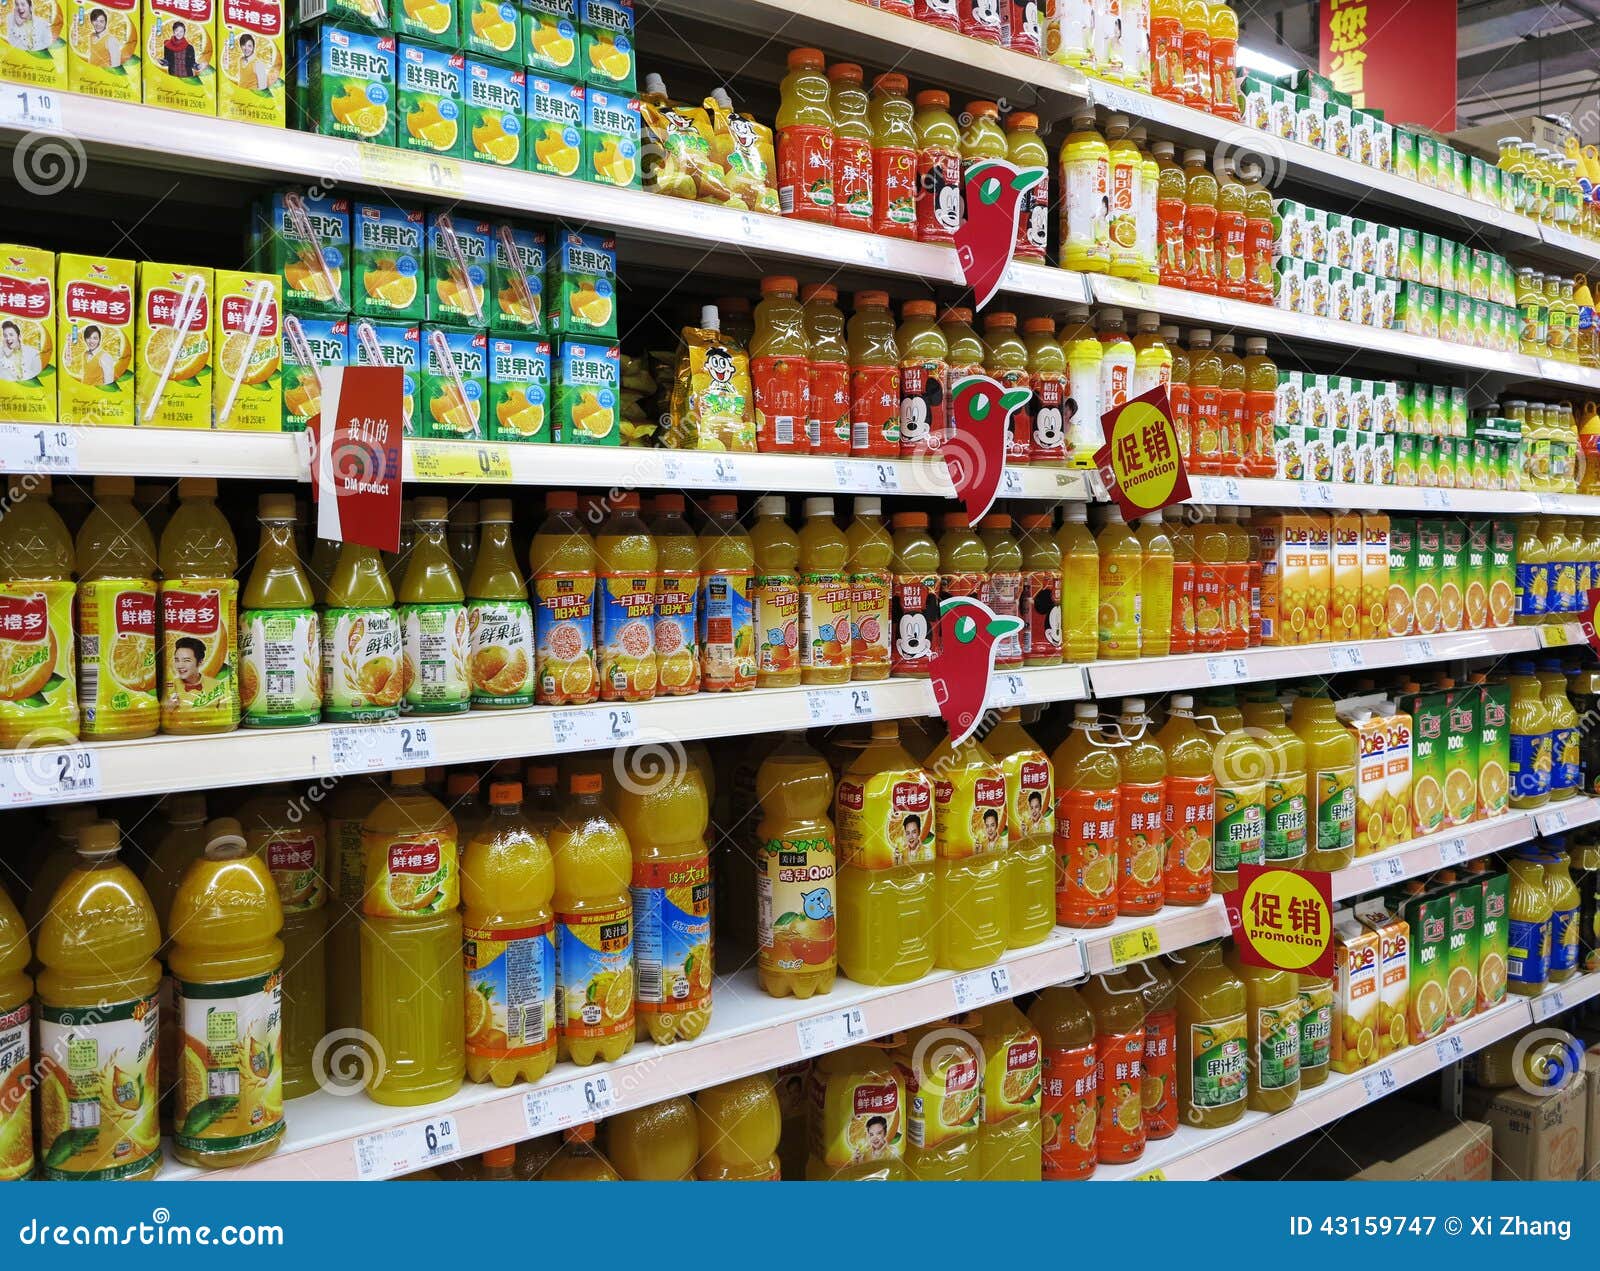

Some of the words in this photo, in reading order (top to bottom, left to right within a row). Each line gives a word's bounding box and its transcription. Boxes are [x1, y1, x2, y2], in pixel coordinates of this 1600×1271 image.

[228, 7, 276, 26] 鲜橙多
[588, 3, 630, 28] 鲜果饮
[331, 47, 388, 75] 鲜果饮
[407, 63, 458, 92] 鲜果饮
[38, 95, 51, 109] 10
[472, 80, 520, 108] 鲜果饮
[535, 95, 580, 120] 鲜果饮
[593, 108, 635, 132] 鲜果饮
[363, 222, 417, 248] 鲜果饮
[569, 248, 611, 271] 鲜果饮
[72, 287, 96, 297] 统一
[153, 294, 176, 304] 统一
[72, 298, 126, 315] 鲜橙多
[153, 305, 203, 321] 鲜多
[227, 301, 248, 310] 统一
[228, 311, 274, 327] 鲜多
[496, 356, 545, 377] 鲜果饮
[571, 360, 614, 381] 鲜果饮
[348, 417, 389, 443] 我们的
[34, 430, 46, 457] 1
[54, 432, 67, 446] 10
[1117, 420, 1171, 475] 促销
[877, 464, 886, 483] 3
[1004, 470, 1013, 487] 3
[1122, 460, 1176, 492] promotion
[344, 477, 357, 491] DM
[358, 480, 389, 496] product
[1285, 527, 1307, 543] Dole
[1337, 528, 1357, 543] Dole
[1366, 527, 1387, 543] Dole
[1390, 554, 1405, 568] 00%
[121, 598, 143, 608] 统一
[903, 597, 922, 607] 饮料
[121, 609, 155, 625] 鲜橙
[481, 611, 508, 624] Tropicana
[479, 623, 522, 645] 鲜果粒
[1008, 676, 1017, 695] 3
[851, 690, 861, 711] 2
[609, 711, 620, 733] 2
[622, 711, 632, 723] 50
[400, 729, 413, 753] 2
[57, 755, 73, 783] 2
[78, 754, 91, 769] 30
[1022, 770, 1047, 784] 鲜橙多
[895, 792, 929, 806] 鲜橙多
[976, 788, 1004, 802] 鲜橙多
[392, 854, 436, 868] 鲜橙多
[1250, 891, 1321, 936] 促销
[604, 924, 628, 939] 美汁源
[1250, 928, 1323, 948] promotion
[1383, 933, 1407, 960] Dole
[1349, 946, 1375, 972] Dole
[991, 971, 999, 991] 6
[842, 1013, 852, 1035] 7
[852, 1011, 861, 1023] 00
[1009, 1051, 1037, 1066] 鲜橙多
[585, 1081, 596, 1105] 6
[597, 1078, 607, 1093] 00
[856, 1091, 896, 1109] 鲜橙多
[425, 1124, 438, 1151] 6
[439, 1121, 451, 1137] 20
